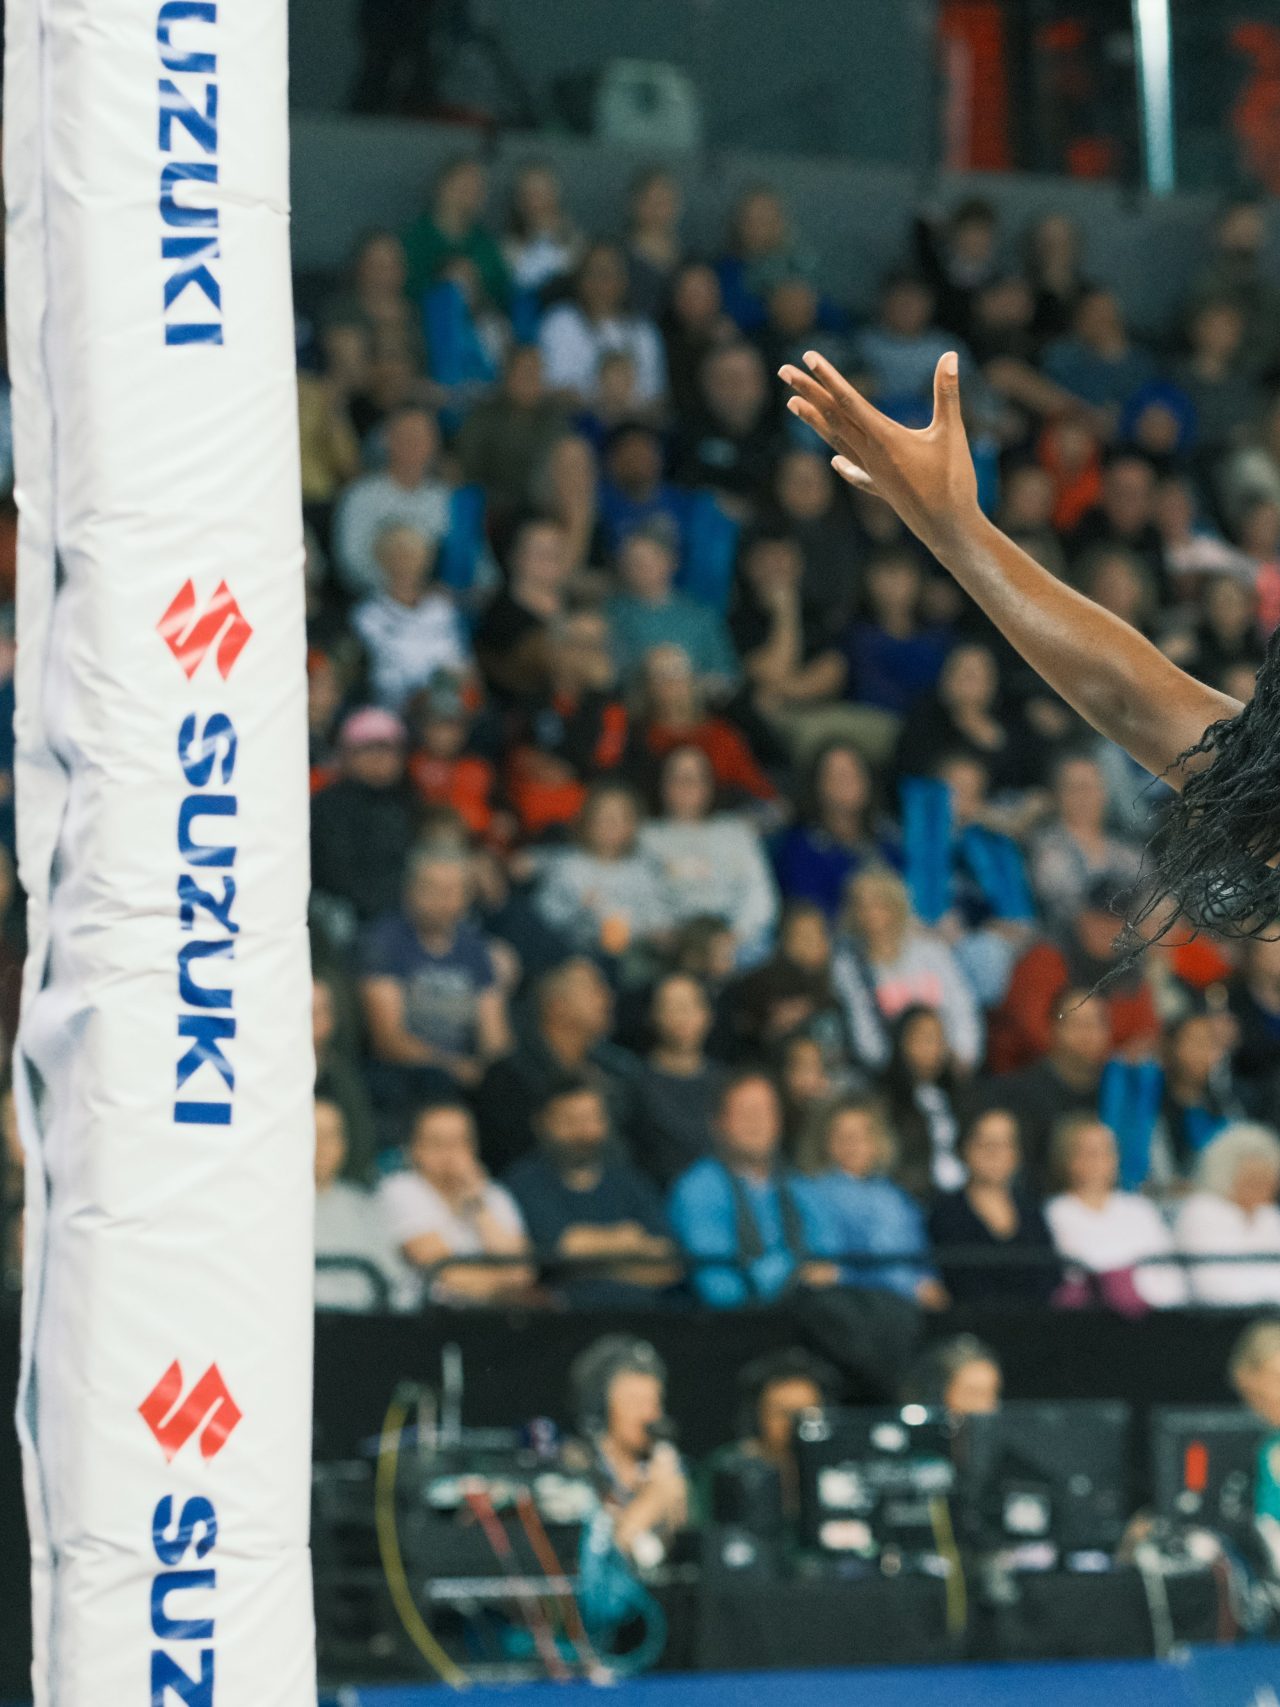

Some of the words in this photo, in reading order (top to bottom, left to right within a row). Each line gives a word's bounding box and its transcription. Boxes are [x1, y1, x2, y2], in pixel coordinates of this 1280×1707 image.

[155, 1, 223, 346] UZUKI
[174, 712, 240, 1125] SUZUKI
[149, 1494, 218, 1707] SUZ
